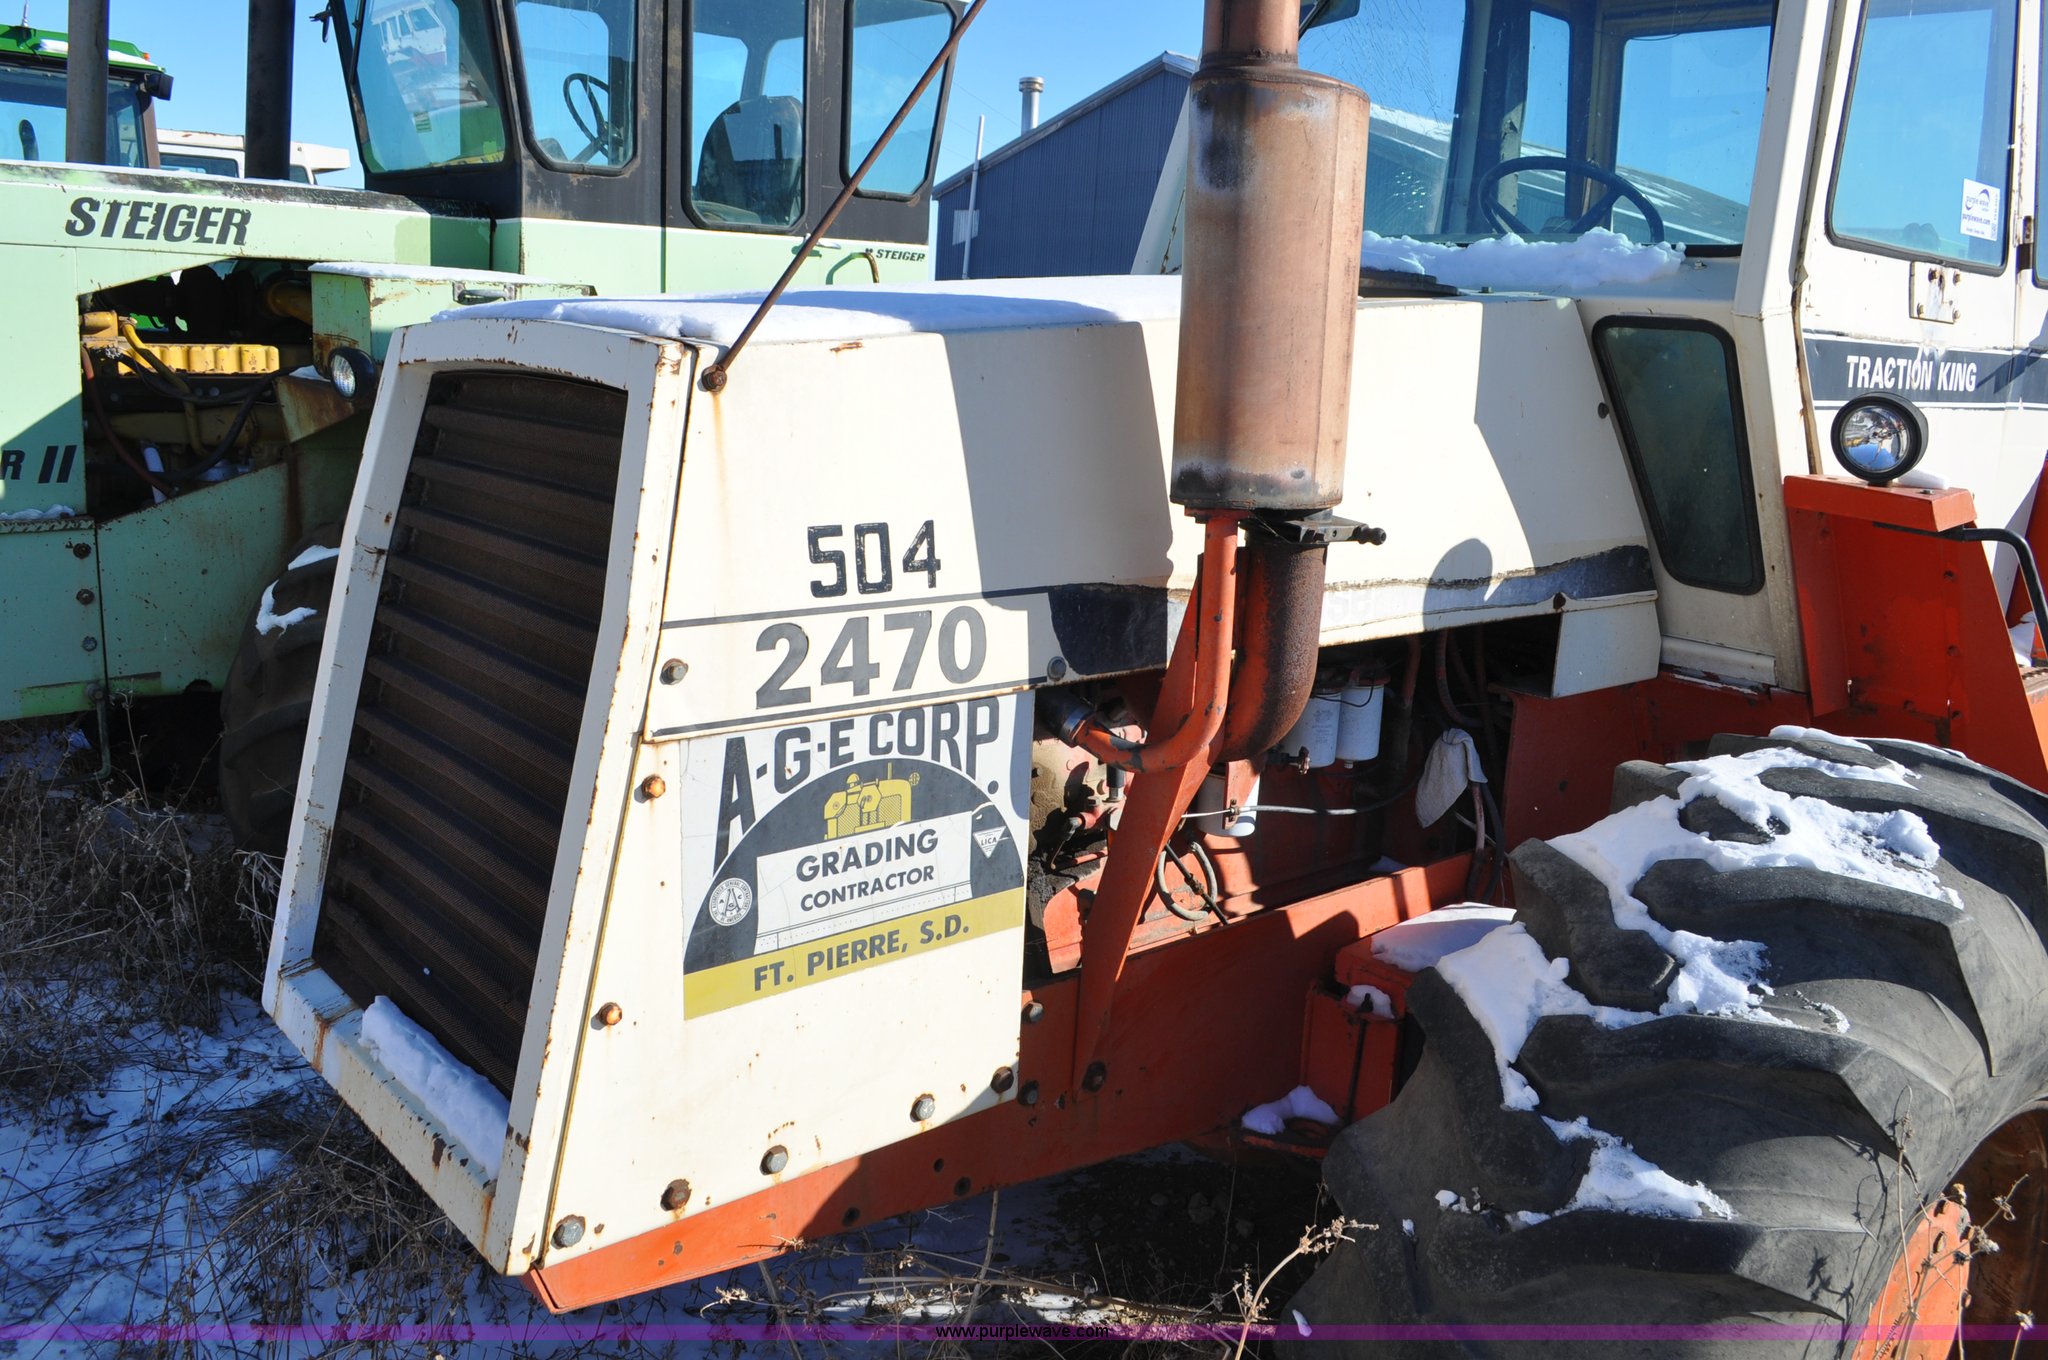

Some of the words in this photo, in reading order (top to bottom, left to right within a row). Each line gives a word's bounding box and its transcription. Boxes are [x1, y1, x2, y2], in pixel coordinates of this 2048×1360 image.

[65, 197, 251, 246] STEIGER
[876, 249, 925, 262] STEIGER
[1846, 355, 1933, 391] TRACTION
[1937, 361, 1977, 392] KING
[807, 519, 941, 598] 504
[756, 606, 987, 710] 2470
[868, 696, 999, 795] CORP.
[796, 829, 938, 882] GRADING
[981, 837, 997, 845] LICA
[800, 865, 934, 911] CONTRACTOR
[754, 961, 794, 991] FT.
[808, 930, 907, 976] PIERRE,
[920, 914, 969, 944] S.D.
